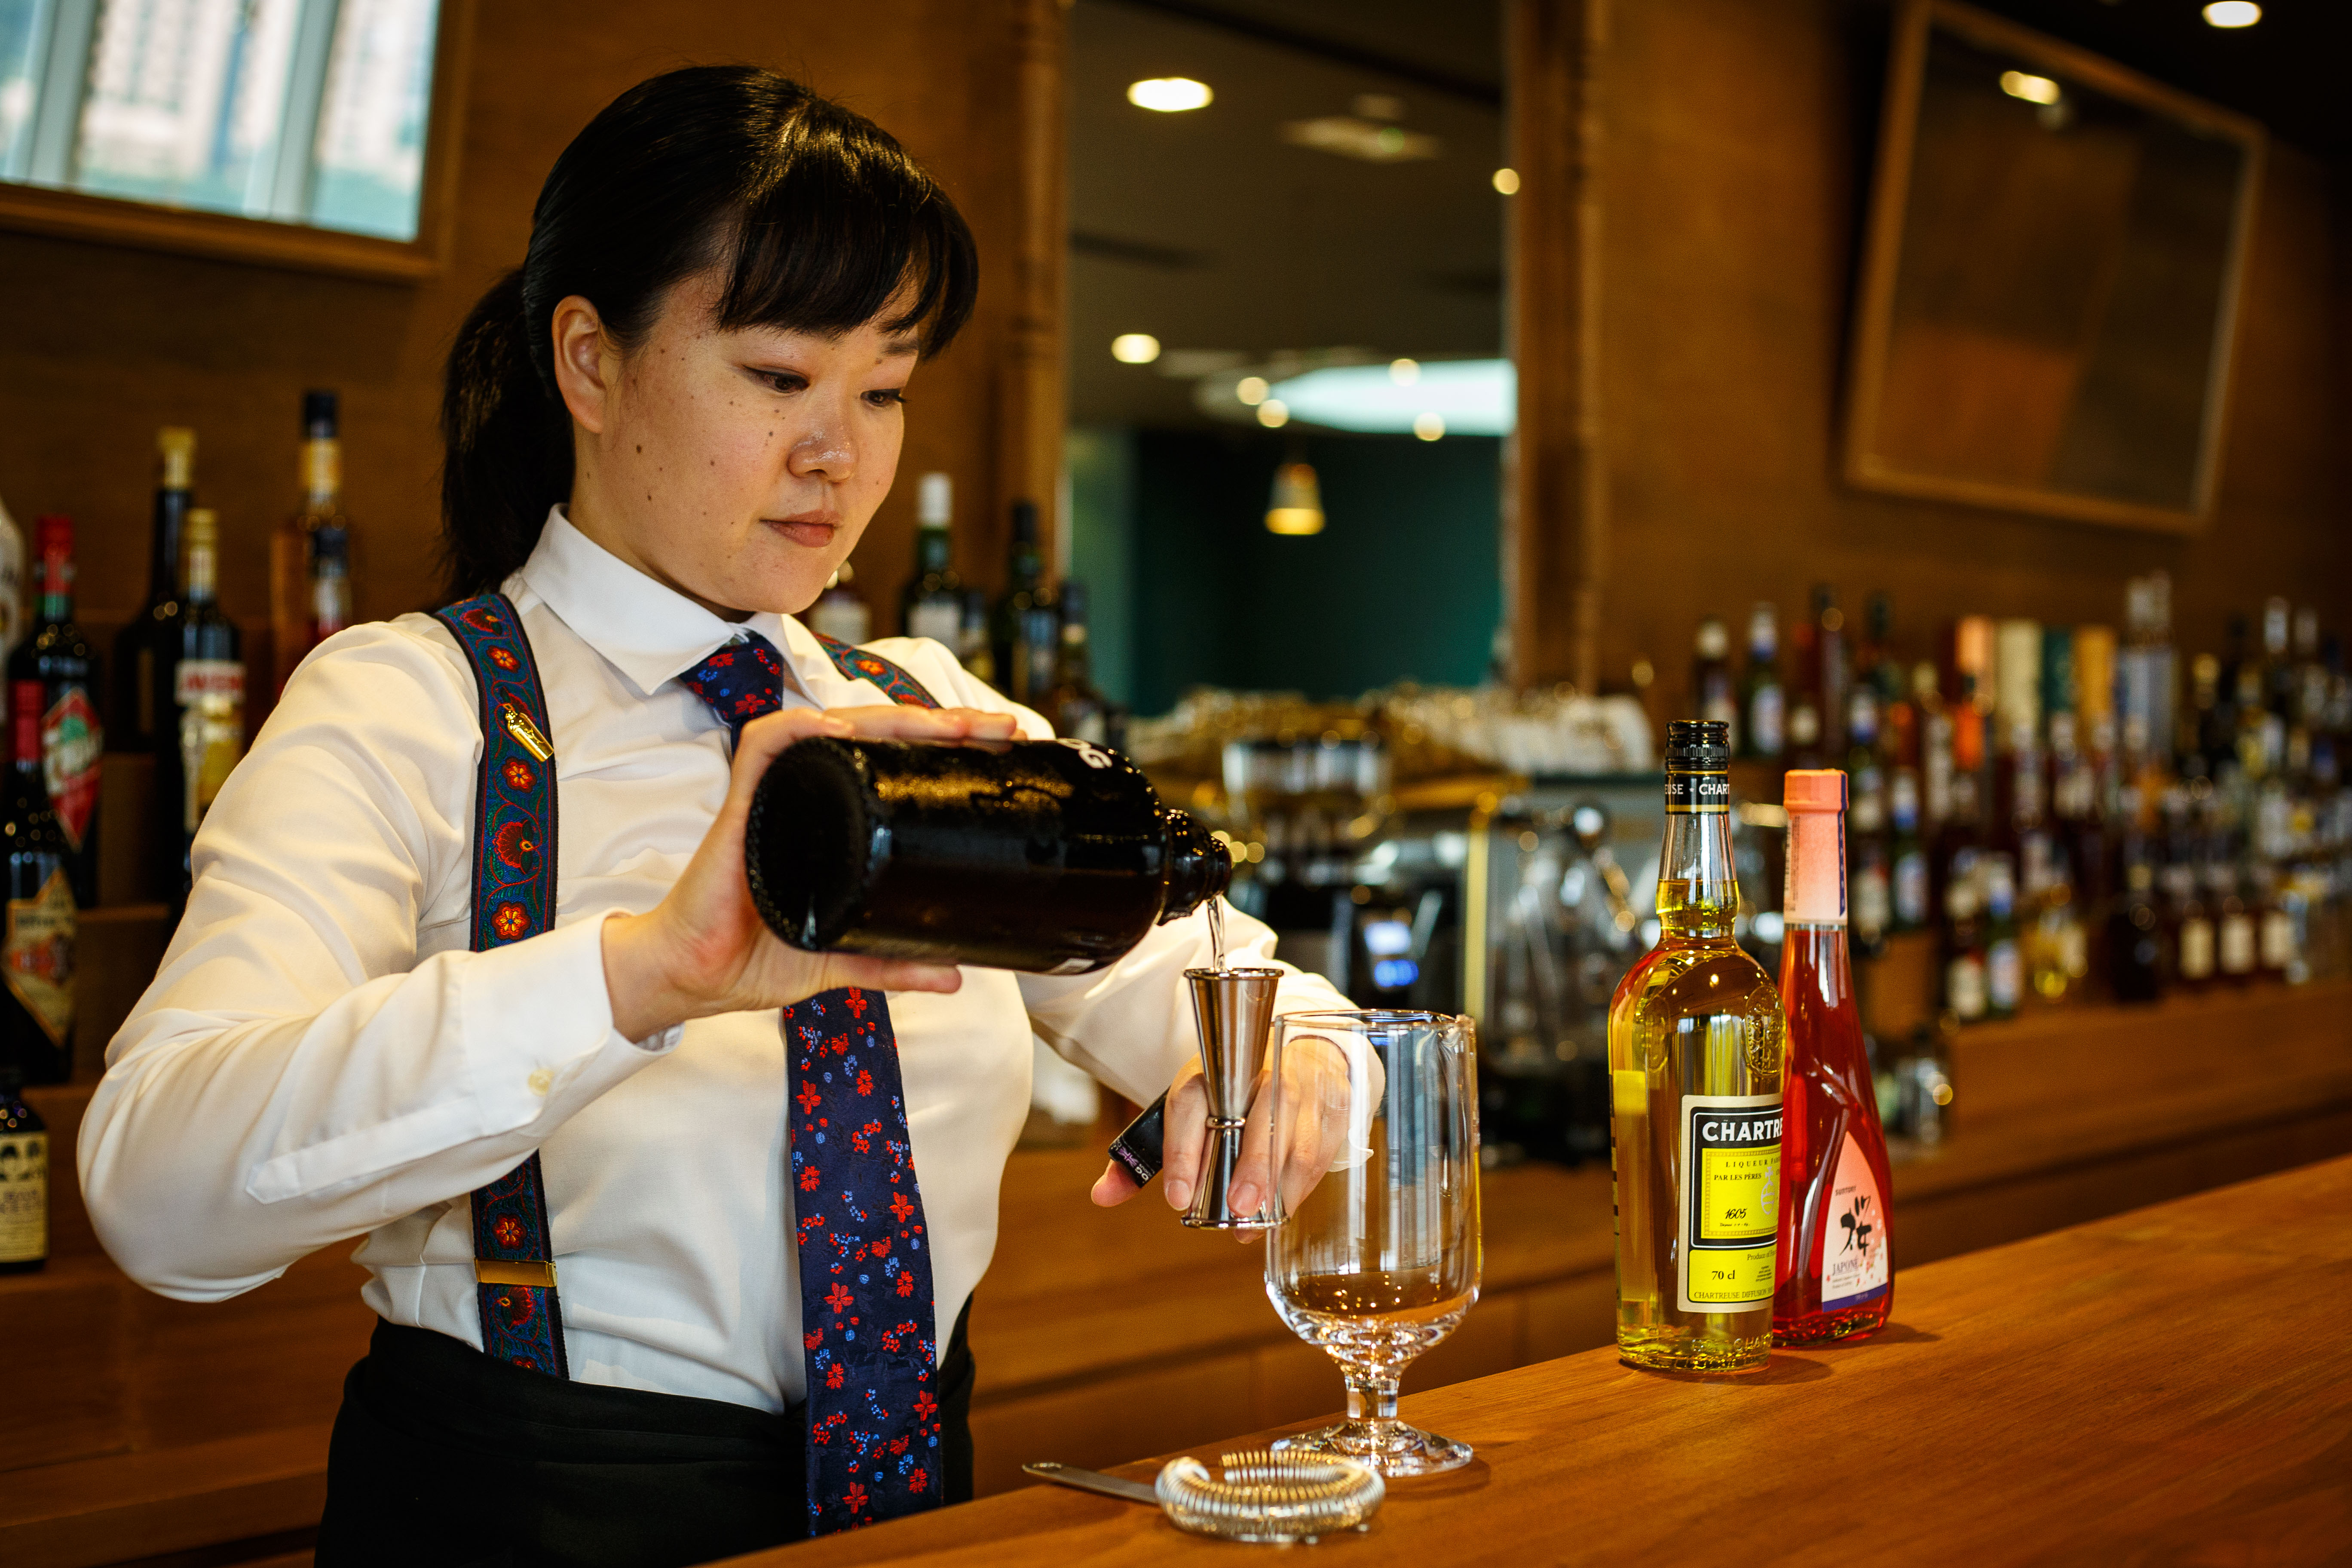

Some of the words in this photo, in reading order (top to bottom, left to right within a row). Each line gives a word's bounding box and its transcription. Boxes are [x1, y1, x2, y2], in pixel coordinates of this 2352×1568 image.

[1726, 1159, 1767, 1168] LIQUEUR
[1725, 1208, 1747, 1219] 1605
[1712, 1271, 1724, 1280] 70
[1727, 1270, 1736, 1280] cl
[1694, 1291, 1740, 1299] CHARTREUSE
[1742, 1288, 1767, 1298] DIFFUSION
